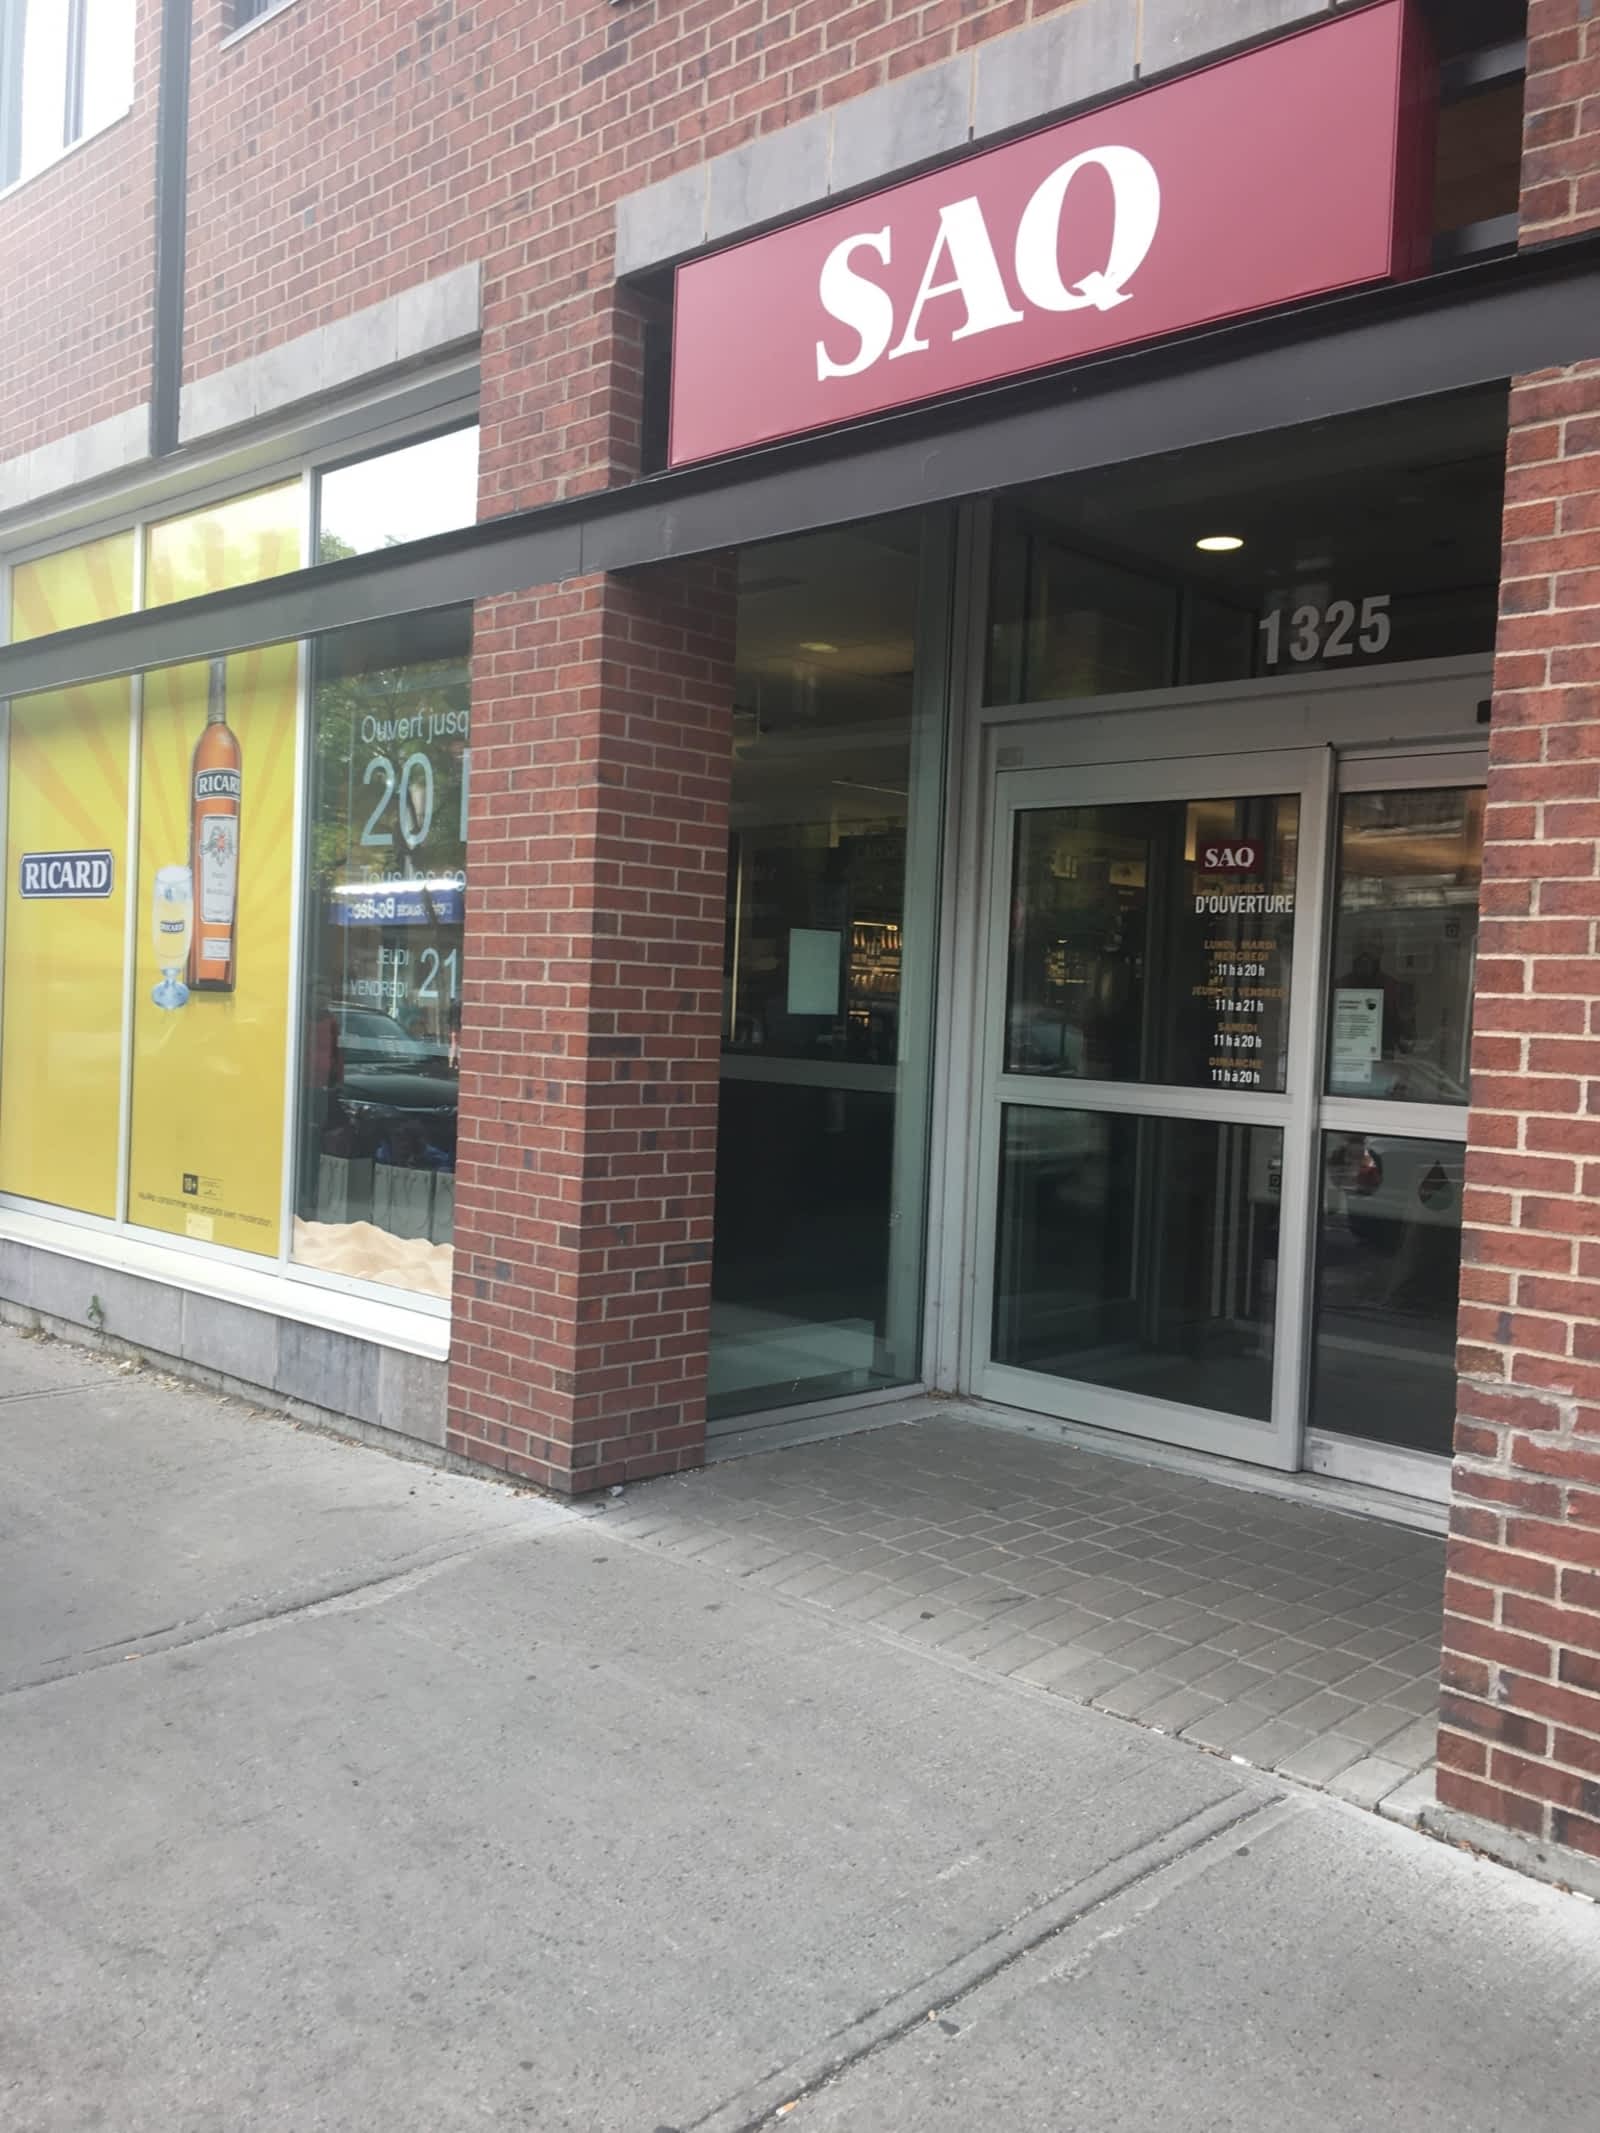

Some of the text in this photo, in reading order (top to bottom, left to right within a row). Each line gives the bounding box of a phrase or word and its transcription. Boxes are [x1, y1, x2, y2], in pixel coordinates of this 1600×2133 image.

[815, 144, 1161, 382] SAQ
[1258, 594, 1391, 665] 1325
[361, 710, 423, 743] Ouvert
[360, 752, 434, 847] 20
[25, 860, 107, 889] RICARD
[1204, 847, 1255, 868] SAQ
[1195, 895, 1294, 914] D'OUVERTURE
[418, 947, 457, 999] 21
